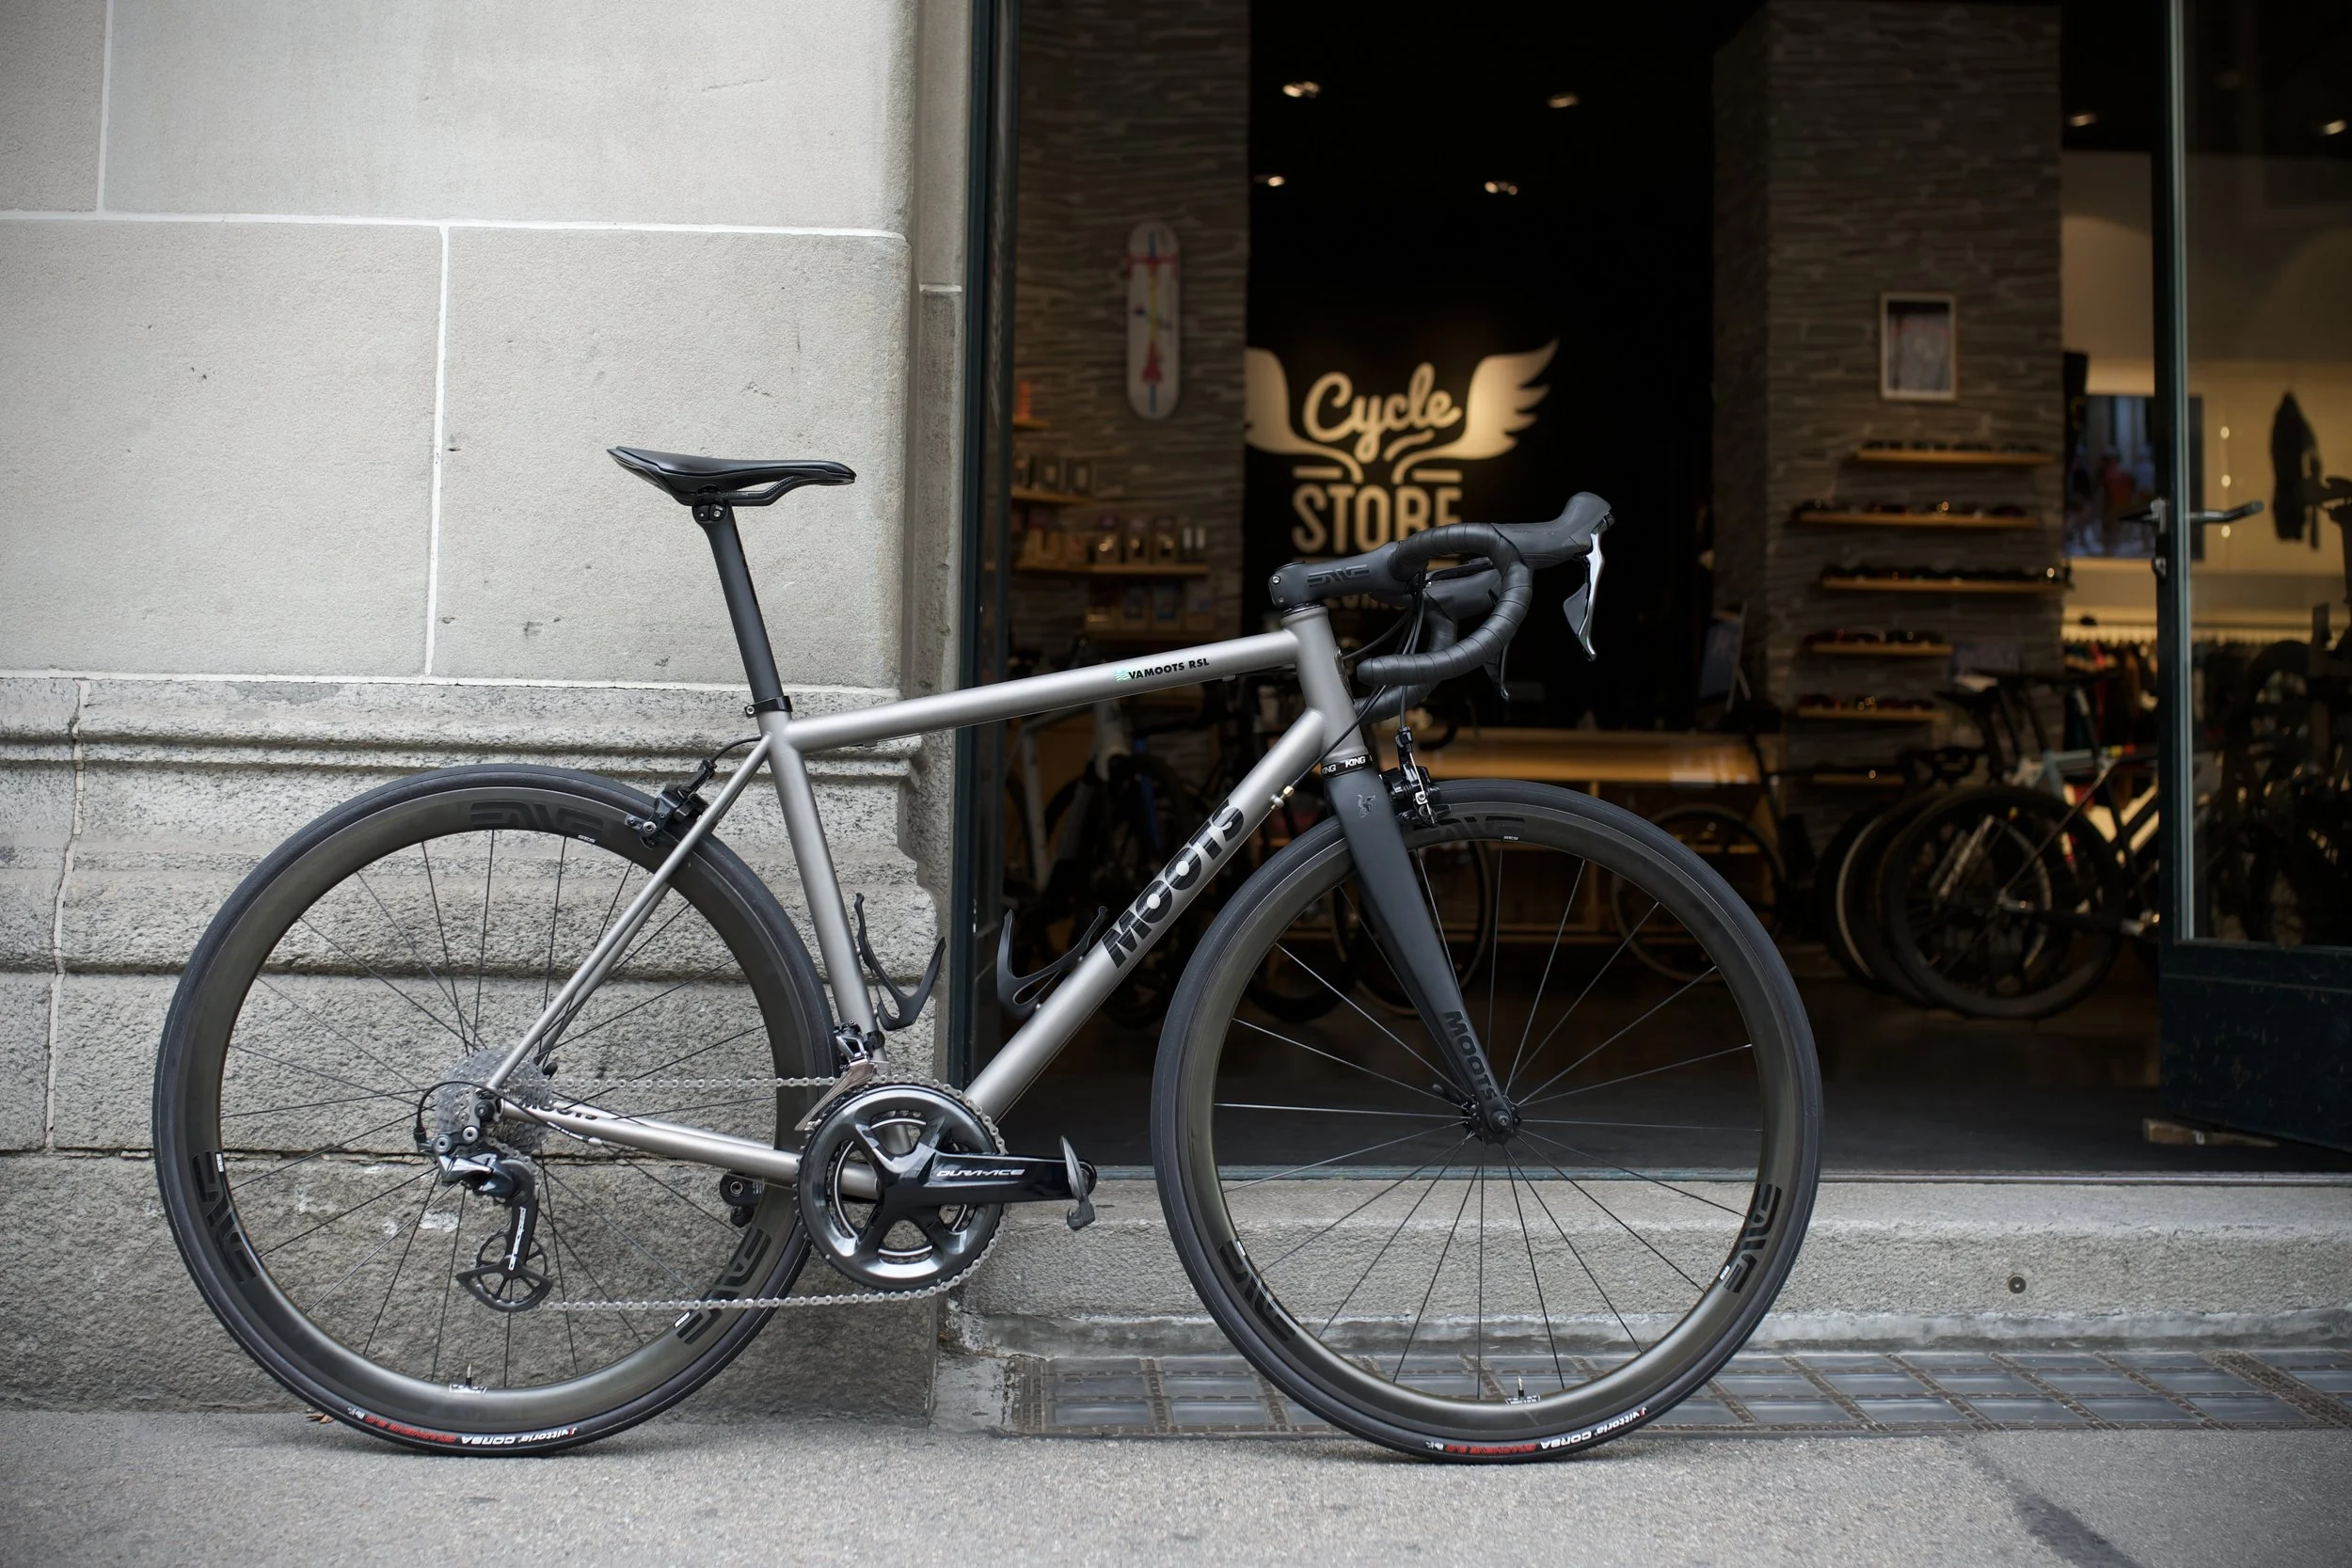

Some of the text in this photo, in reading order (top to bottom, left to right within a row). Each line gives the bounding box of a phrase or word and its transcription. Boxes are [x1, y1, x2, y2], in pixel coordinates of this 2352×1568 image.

[1303, 362, 1462, 464] Cycle
[1129, 657, 1210, 680] VAMOOTS RSL
[1344, 755, 1366, 768] KING
[1102, 799, 1245, 969] MOOTS
[1441, 1010, 1499, 1101] MOOTS
[936, 1168, 1026, 1178] DURA-ACE
[1597, 1411, 1641, 1434] vittoria
[520, 1428, 569, 1443] vittoria
